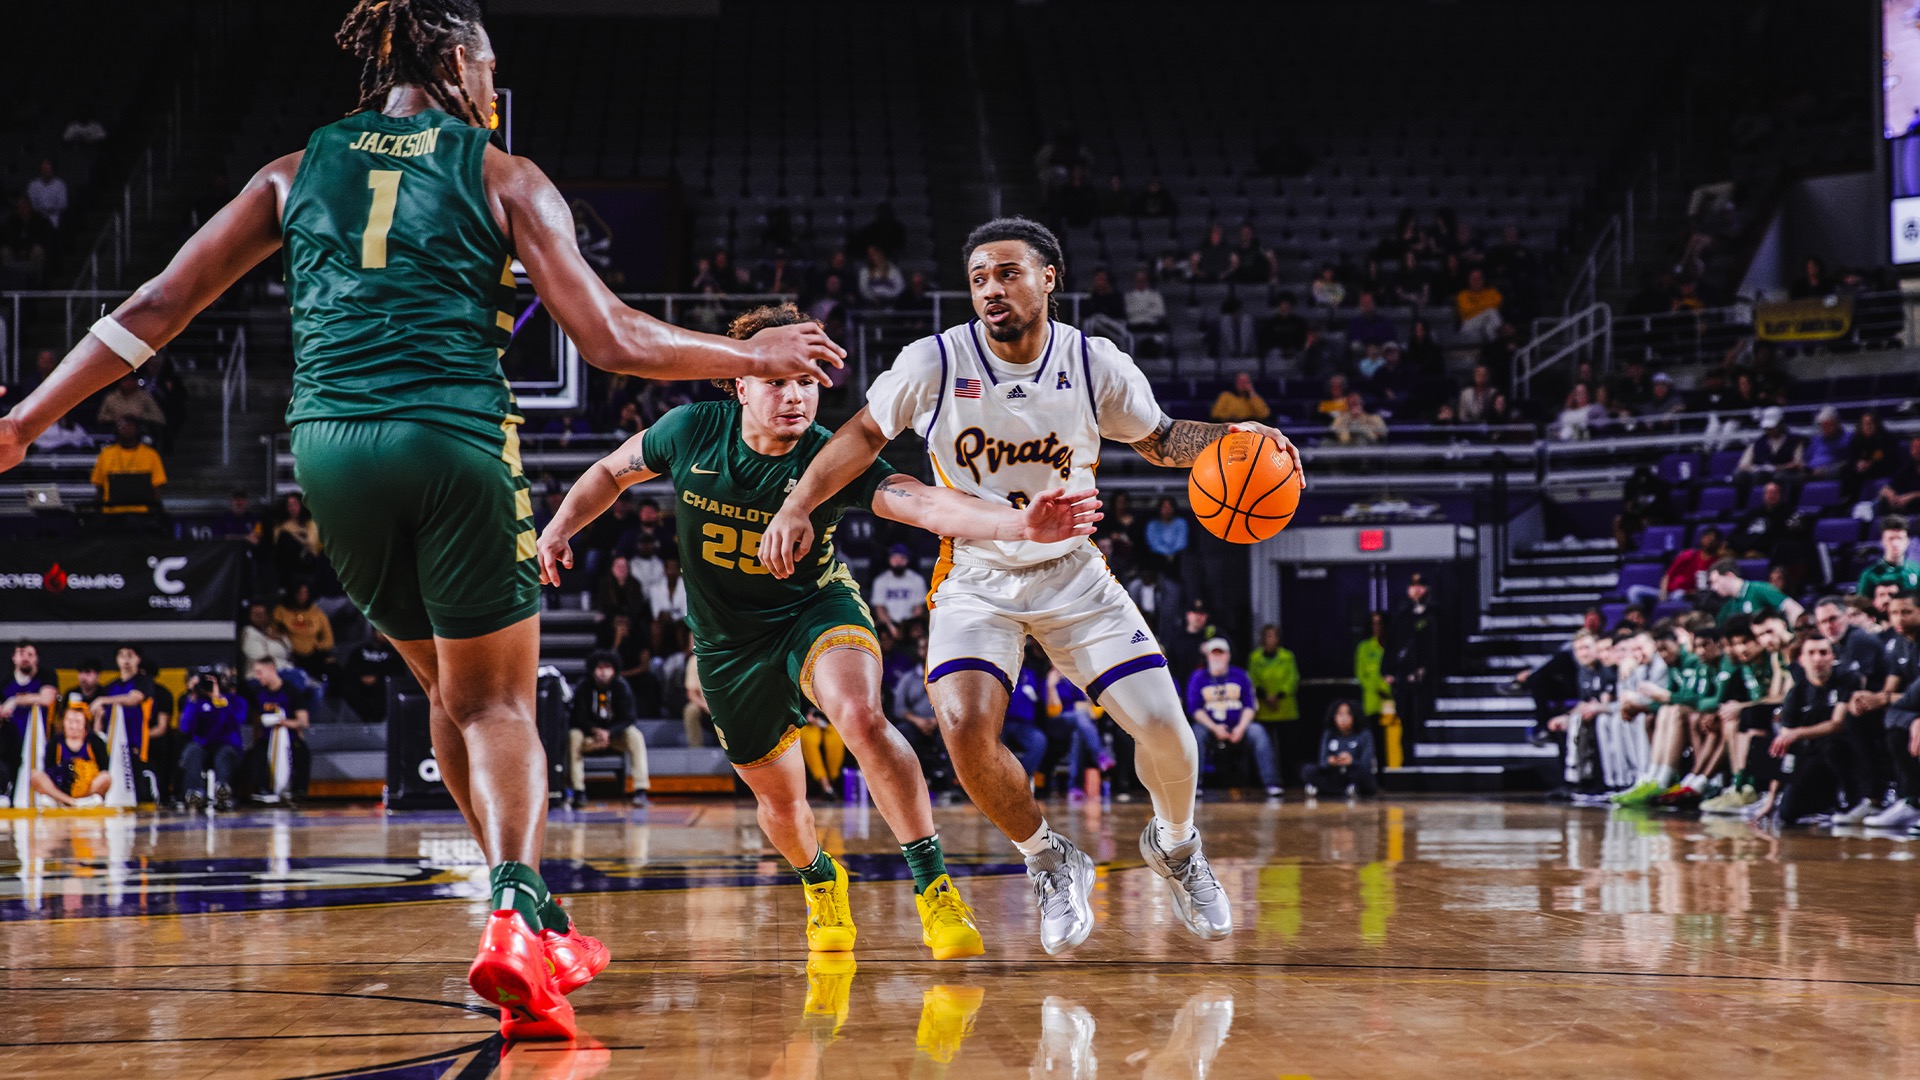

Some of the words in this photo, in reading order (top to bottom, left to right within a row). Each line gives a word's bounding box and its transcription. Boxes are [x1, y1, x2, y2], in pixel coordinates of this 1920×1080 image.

[349, 127, 441, 157] JACKSON
[362, 169, 403, 268] 1
[955, 426, 1074, 486] Pirates
[682, 490, 778, 525] CHARLOT
[702, 522, 771, 575] 25
[67, 573, 124, 589] GAMING
